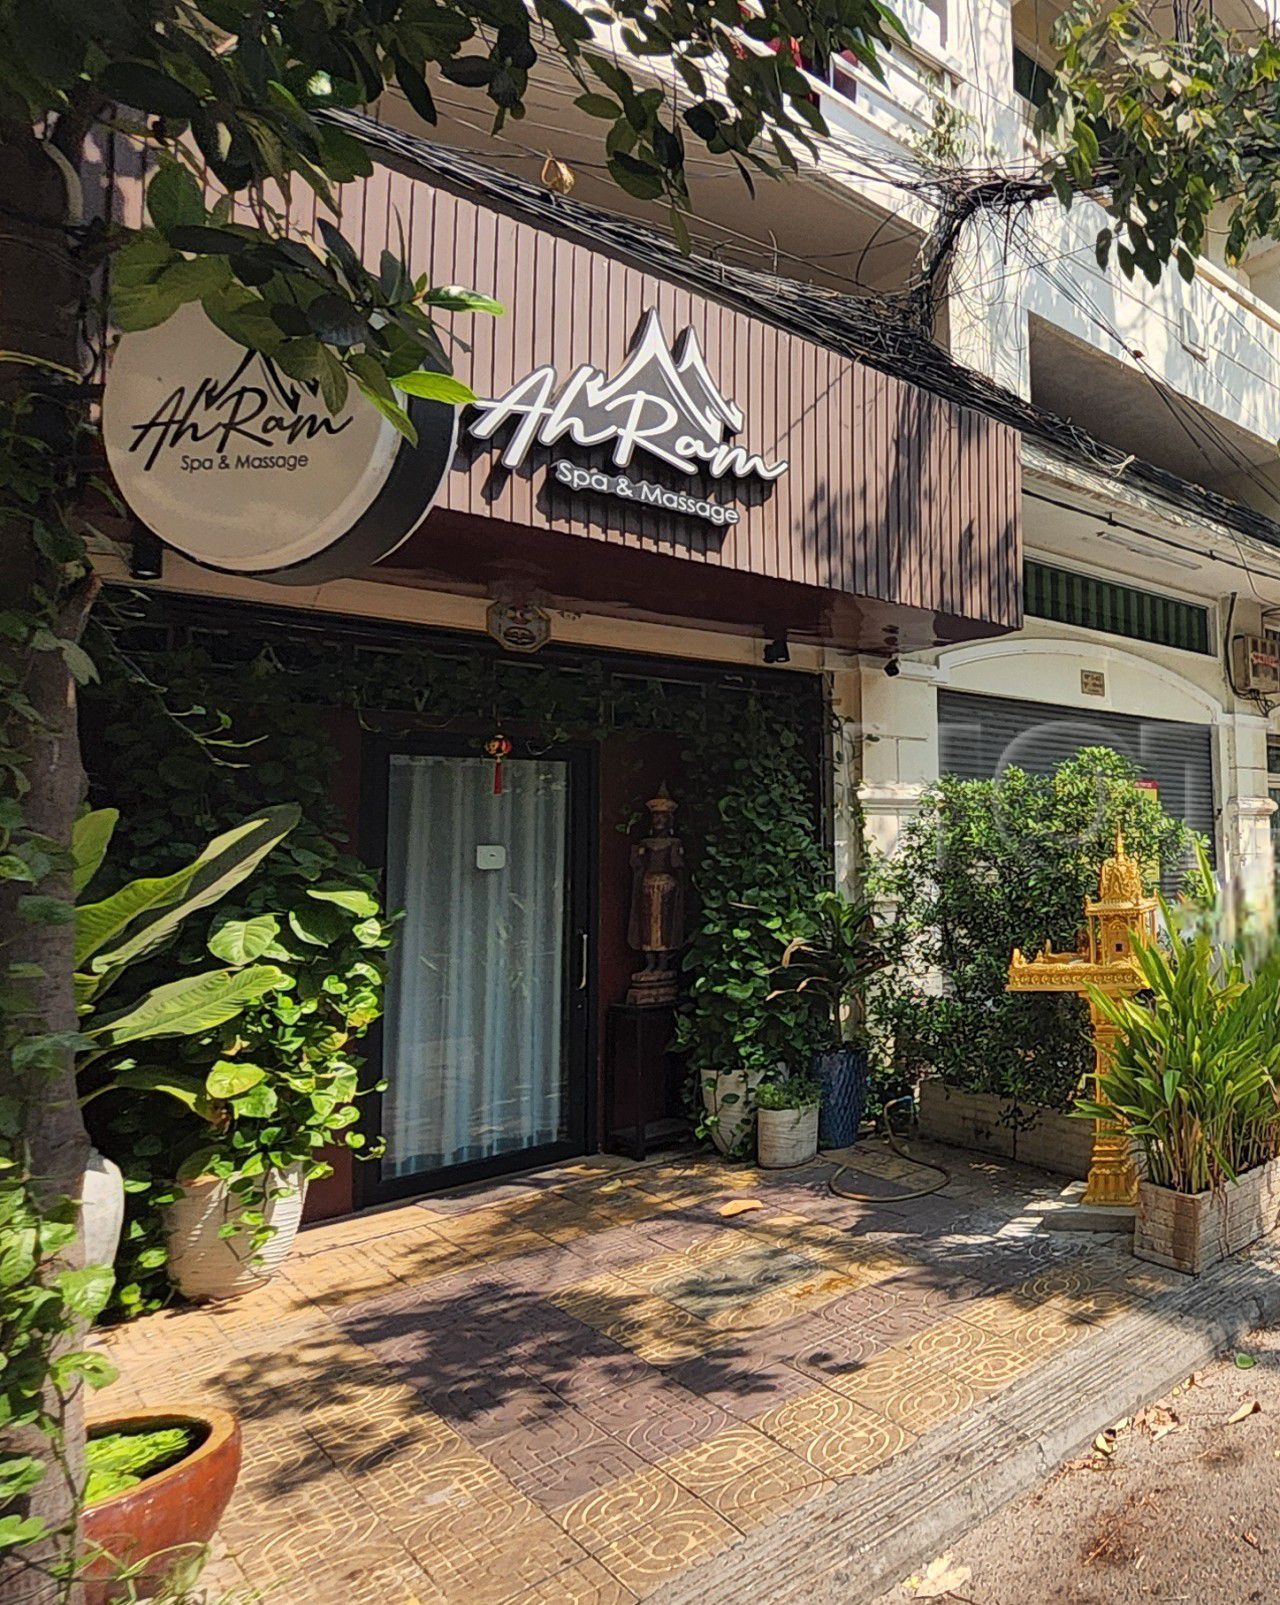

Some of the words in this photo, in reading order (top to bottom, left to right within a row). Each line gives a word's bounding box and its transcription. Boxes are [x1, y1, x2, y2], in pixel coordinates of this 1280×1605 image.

[180, 454, 213, 474] Spa
[220, 454, 230, 470] &
[235, 453, 309, 471] Massage
[557, 461, 609, 491] Spa
[615, 478, 634, 499] &
[640, 486, 739, 526] Massage
